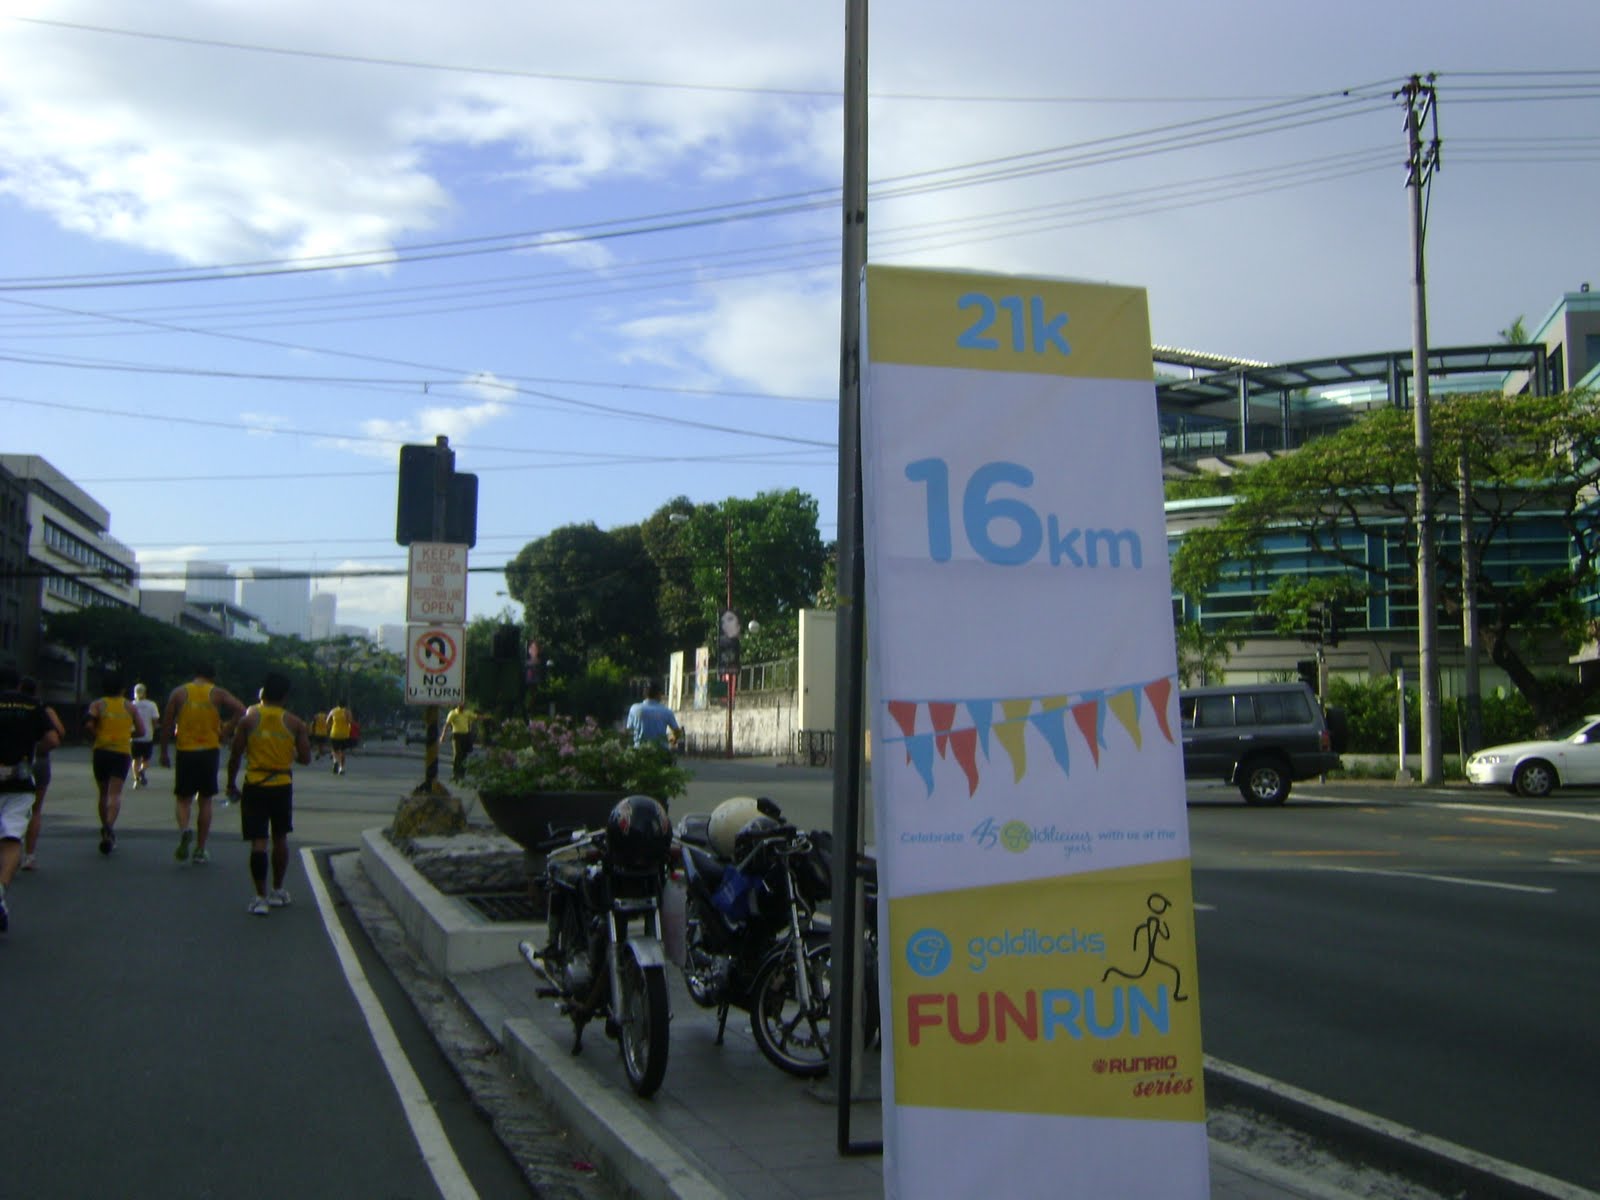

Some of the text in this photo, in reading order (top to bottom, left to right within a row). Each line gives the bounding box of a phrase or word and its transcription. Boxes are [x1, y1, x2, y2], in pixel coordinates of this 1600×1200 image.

[956, 292, 1072, 356] 21k
[904, 457, 1143, 569] 16km
[422, 547, 456, 561] KEEP
[431, 575, 445, 586] AND
[422, 601, 454, 614] OPEN
[423, 674, 447, 686] NO
[900, 830, 964, 844] Celebrate
[971, 816, 1001, 849] 45
[1098, 828, 1125, 840] with
[1127, 831, 1140, 840] us
[1142, 829, 1156, 840] at
[1157, 828, 1176, 840] the
[967, 928, 1106, 972] goldilocks
[1132, 1072, 1194, 1097] series
